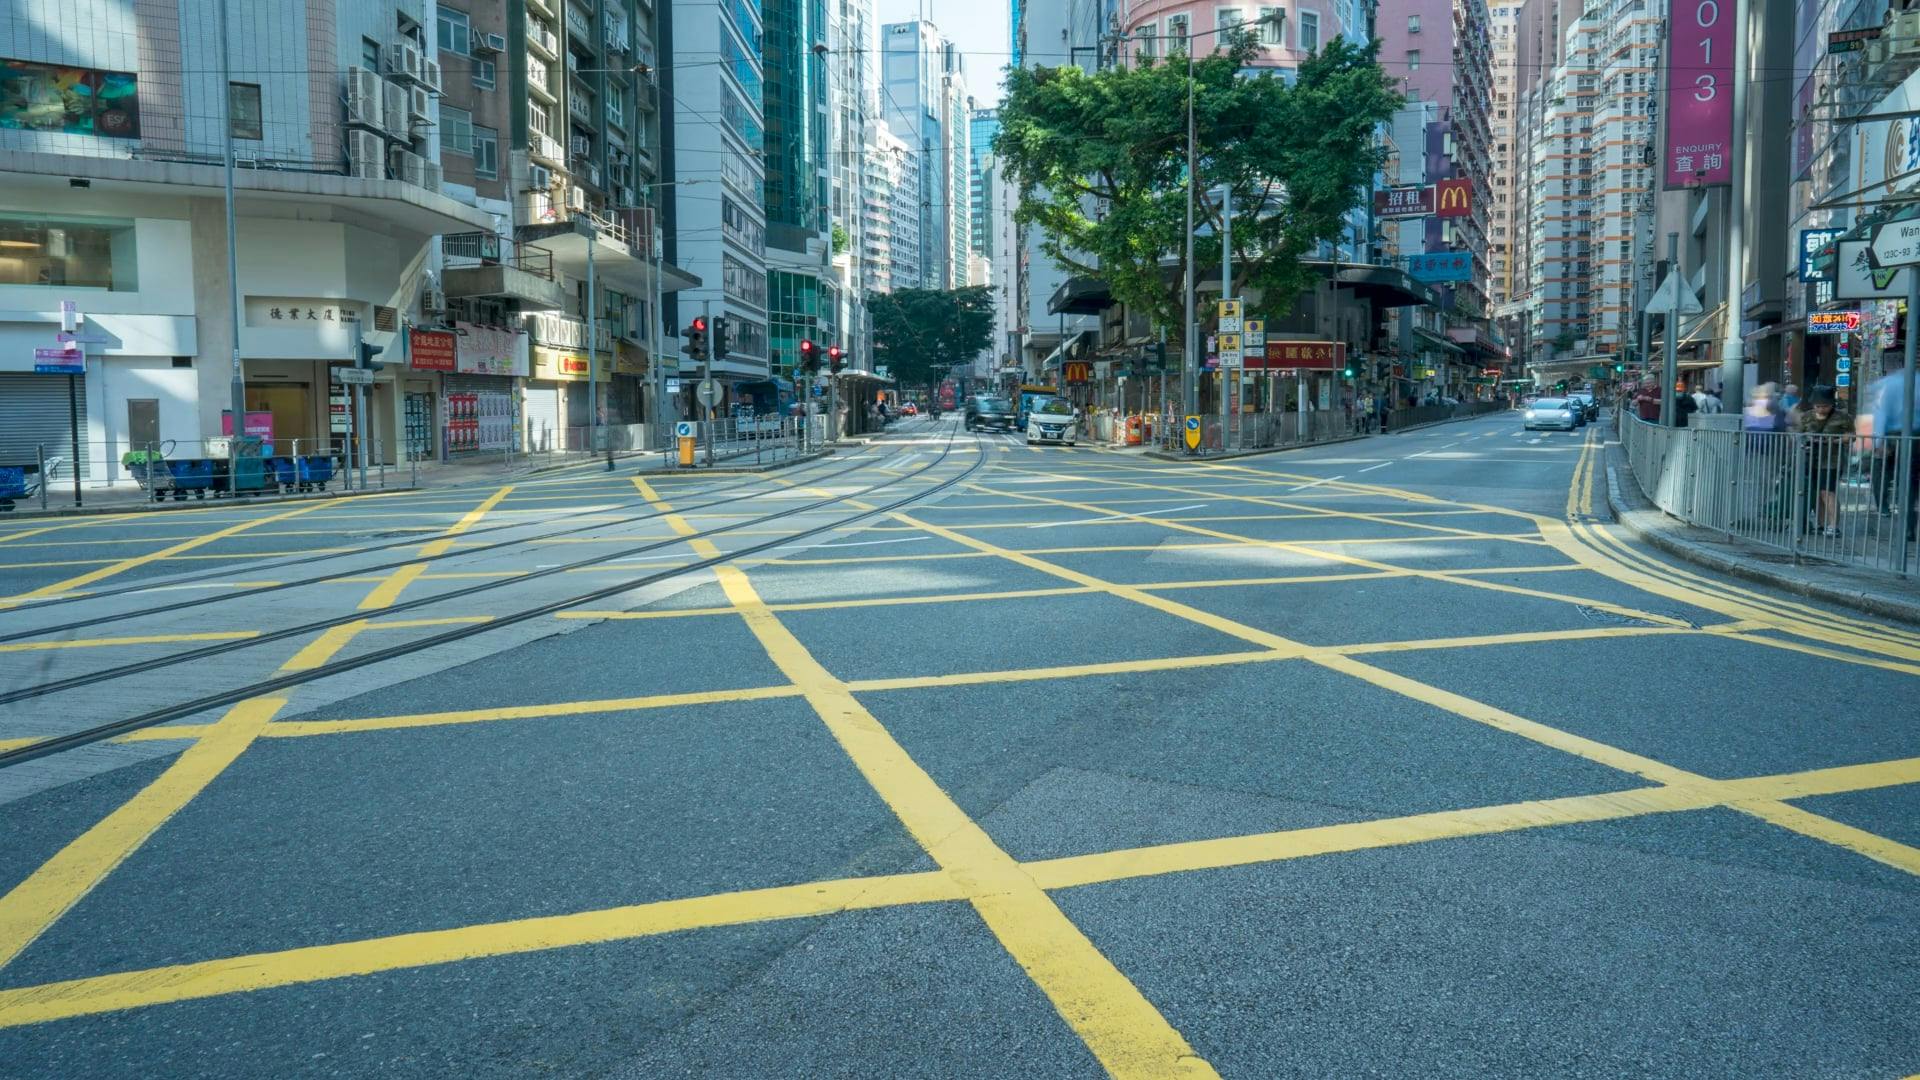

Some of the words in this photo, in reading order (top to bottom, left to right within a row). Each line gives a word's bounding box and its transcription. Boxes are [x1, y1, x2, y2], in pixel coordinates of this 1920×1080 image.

[1676, 143, 1722, 153] ENQUIRY
[1675, 154, 1722, 172] 查詢
[1389, 191, 1419, 206] 招租
[1883, 248, 1911, 259] 123C-93
[270, 307, 335, 321] 德業大廈
